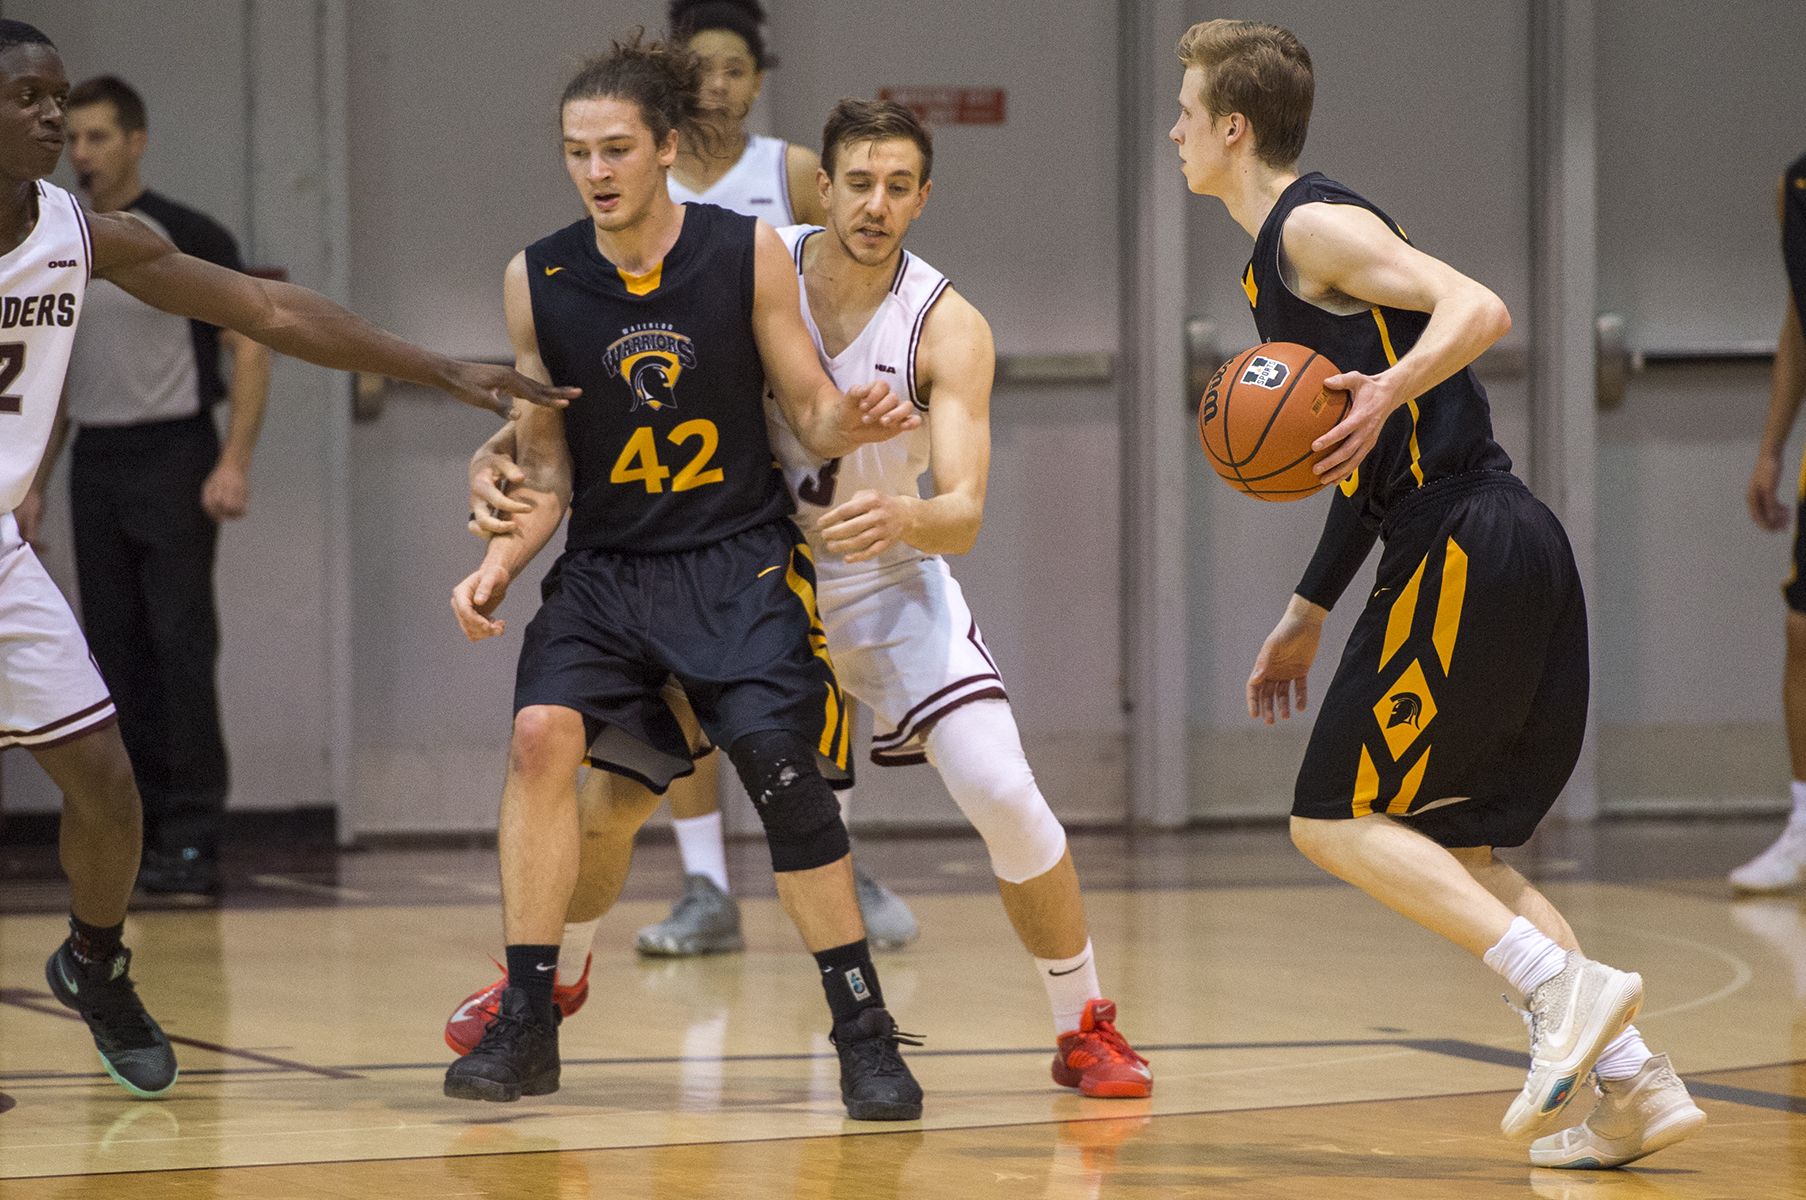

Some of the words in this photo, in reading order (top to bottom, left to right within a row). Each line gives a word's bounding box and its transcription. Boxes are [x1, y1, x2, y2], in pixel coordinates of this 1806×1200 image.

[48, 259, 77, 268] OUA
[602, 333, 698, 379] WARRIORS
[1257, 361, 1276, 385] SPORTS
[610, 418, 724, 493] 42
